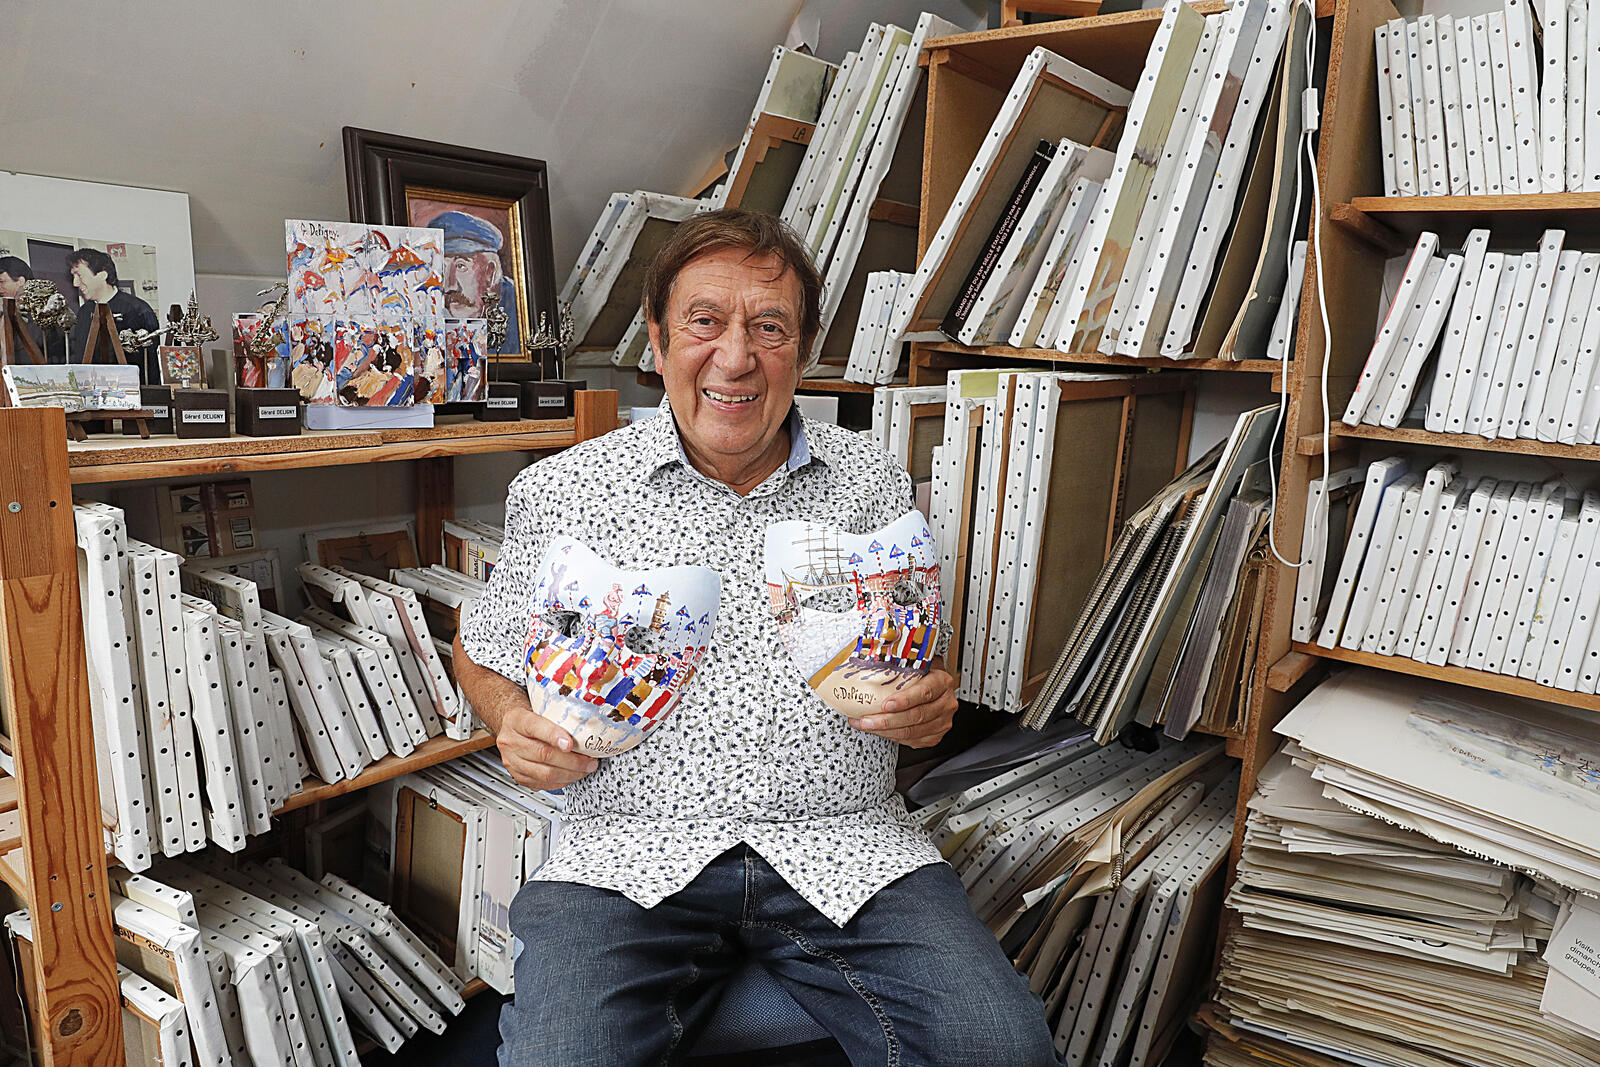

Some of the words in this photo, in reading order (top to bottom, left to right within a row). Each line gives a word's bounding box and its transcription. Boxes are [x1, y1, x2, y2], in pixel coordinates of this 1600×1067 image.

[954, 297, 967, 317] QUAND
[964, 284, 974, 298] L'ART
[971, 275, 979, 284] DU
[981, 248, 994, 265] SIÈCLE
[989, 234, 1001, 248] ÉTAIT
[997, 215, 1011, 235] CONÇU
[1008, 204, 1017, 215] PAR
[1014, 193, 1023, 205] DES
[960, 298, 973, 320] L'histoire
[970, 291, 976, 299] du
[973, 278, 983, 292] Salon
[982, 253, 998, 279] d'Automne,
[994, 244, 1001, 252] de
[1011, 206, 1021, 220] jours
[1565, 953, 1596, 976] groupes,
[1575, 938, 1594, 954] Visite
